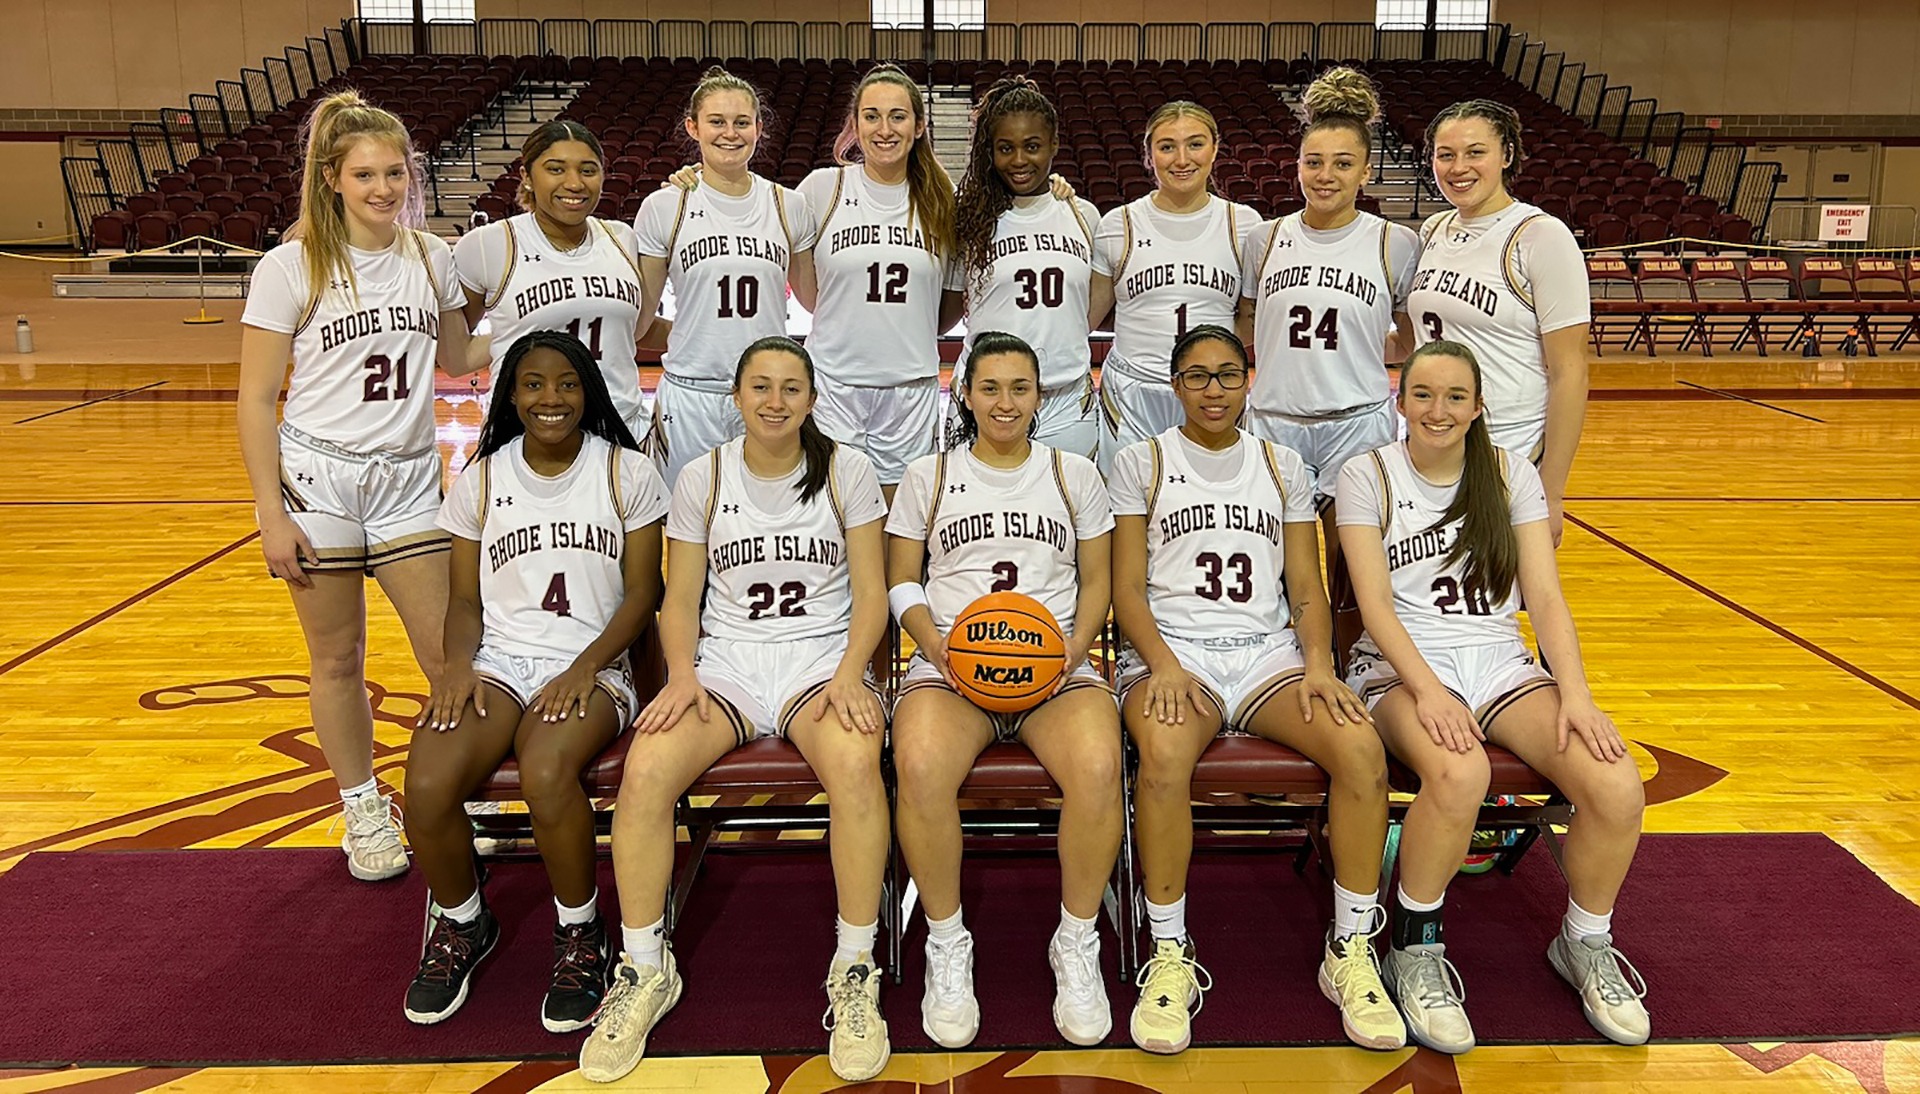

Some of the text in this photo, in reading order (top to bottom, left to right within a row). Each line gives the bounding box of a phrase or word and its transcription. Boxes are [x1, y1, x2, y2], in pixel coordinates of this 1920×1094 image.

[1826, 209, 1865, 217] EMERGENCY
[1835, 228, 1852, 236] ONLY
[1837, 218, 1852, 226] EXIT
[679, 235, 787, 273] RHODE ISLAND
[830, 224, 941, 259] RHODE ISLA
[984, 233, 1089, 265] ODE ISLAND
[515, 277, 577, 320] RHODE
[717, 274, 760, 319] 10
[866, 261, 910, 304] 12
[1013, 266, 1065, 310] 30
[1126, 263, 1236, 300] RHODE ISLAND
[1264, 265, 1312, 300] RHODE
[1317, 265, 1377, 308] ISLAND
[1434, 270, 1498, 317] ISLAND
[320, 306, 439, 353] RHODE ISLAND
[1173, 302, 1188, 342] 1
[1288, 304, 1340, 351] 24
[1422, 310, 1444, 342] 3
[362, 350, 411, 402] 21
[938, 511, 1067, 556] RHODE ISLAND
[1160, 503, 1281, 547] RHODE ISLAND
[488, 521, 618, 575] RHODE ISLAND
[713, 535, 839, 575] RHODE ISLAND
[1387, 528, 1450, 573] RHODE
[541, 570, 571, 617] 4
[990, 560, 1019, 594] 2
[1194, 551, 1253, 604] 33
[1430, 576, 1492, 615] 20
[747, 581, 807, 620] 22
[966, 620, 1043, 648] Wilson
[973, 663, 1034, 685] NCAA
